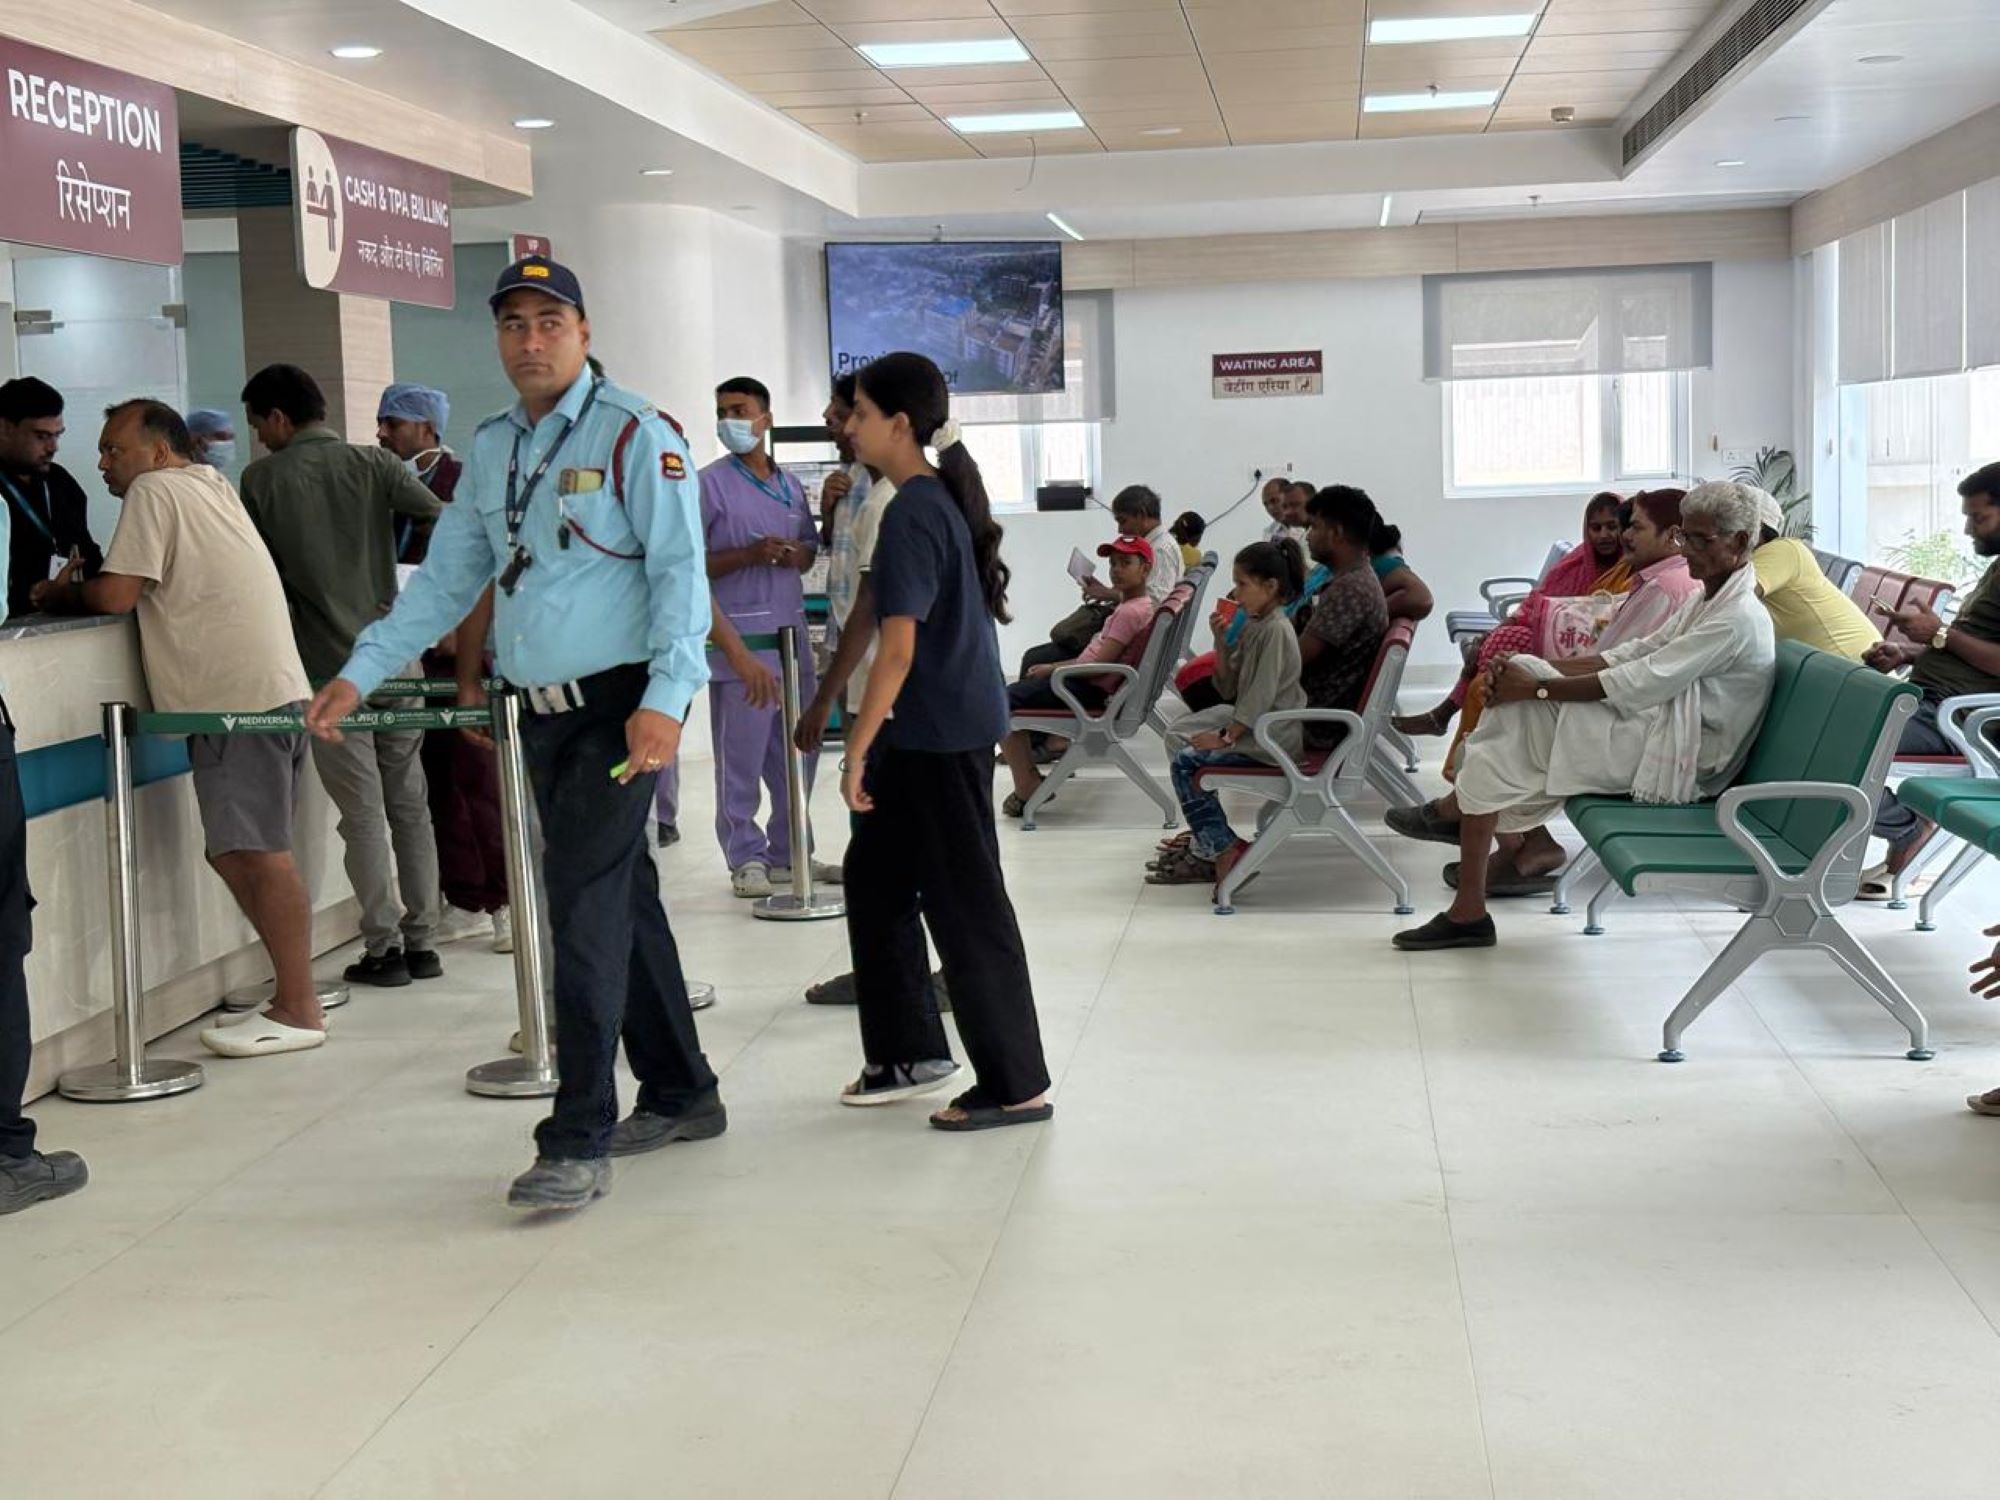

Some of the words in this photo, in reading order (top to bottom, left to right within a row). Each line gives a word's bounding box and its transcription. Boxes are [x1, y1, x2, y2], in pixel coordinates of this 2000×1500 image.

[8, 68, 162, 154] RECEPTION
[56, 159, 131, 231] रिसेप्शन
[345, 175, 376, 210] CASH
[379, 184, 387, 211] &
[387, 186, 410, 218] TPA
[410, 193, 449, 228] BILLING
[1220, 359, 1277, 371] WAITING
[1280, 357, 1316, 368] AREA
[238, 716, 294, 726] MEDIVERSAL
